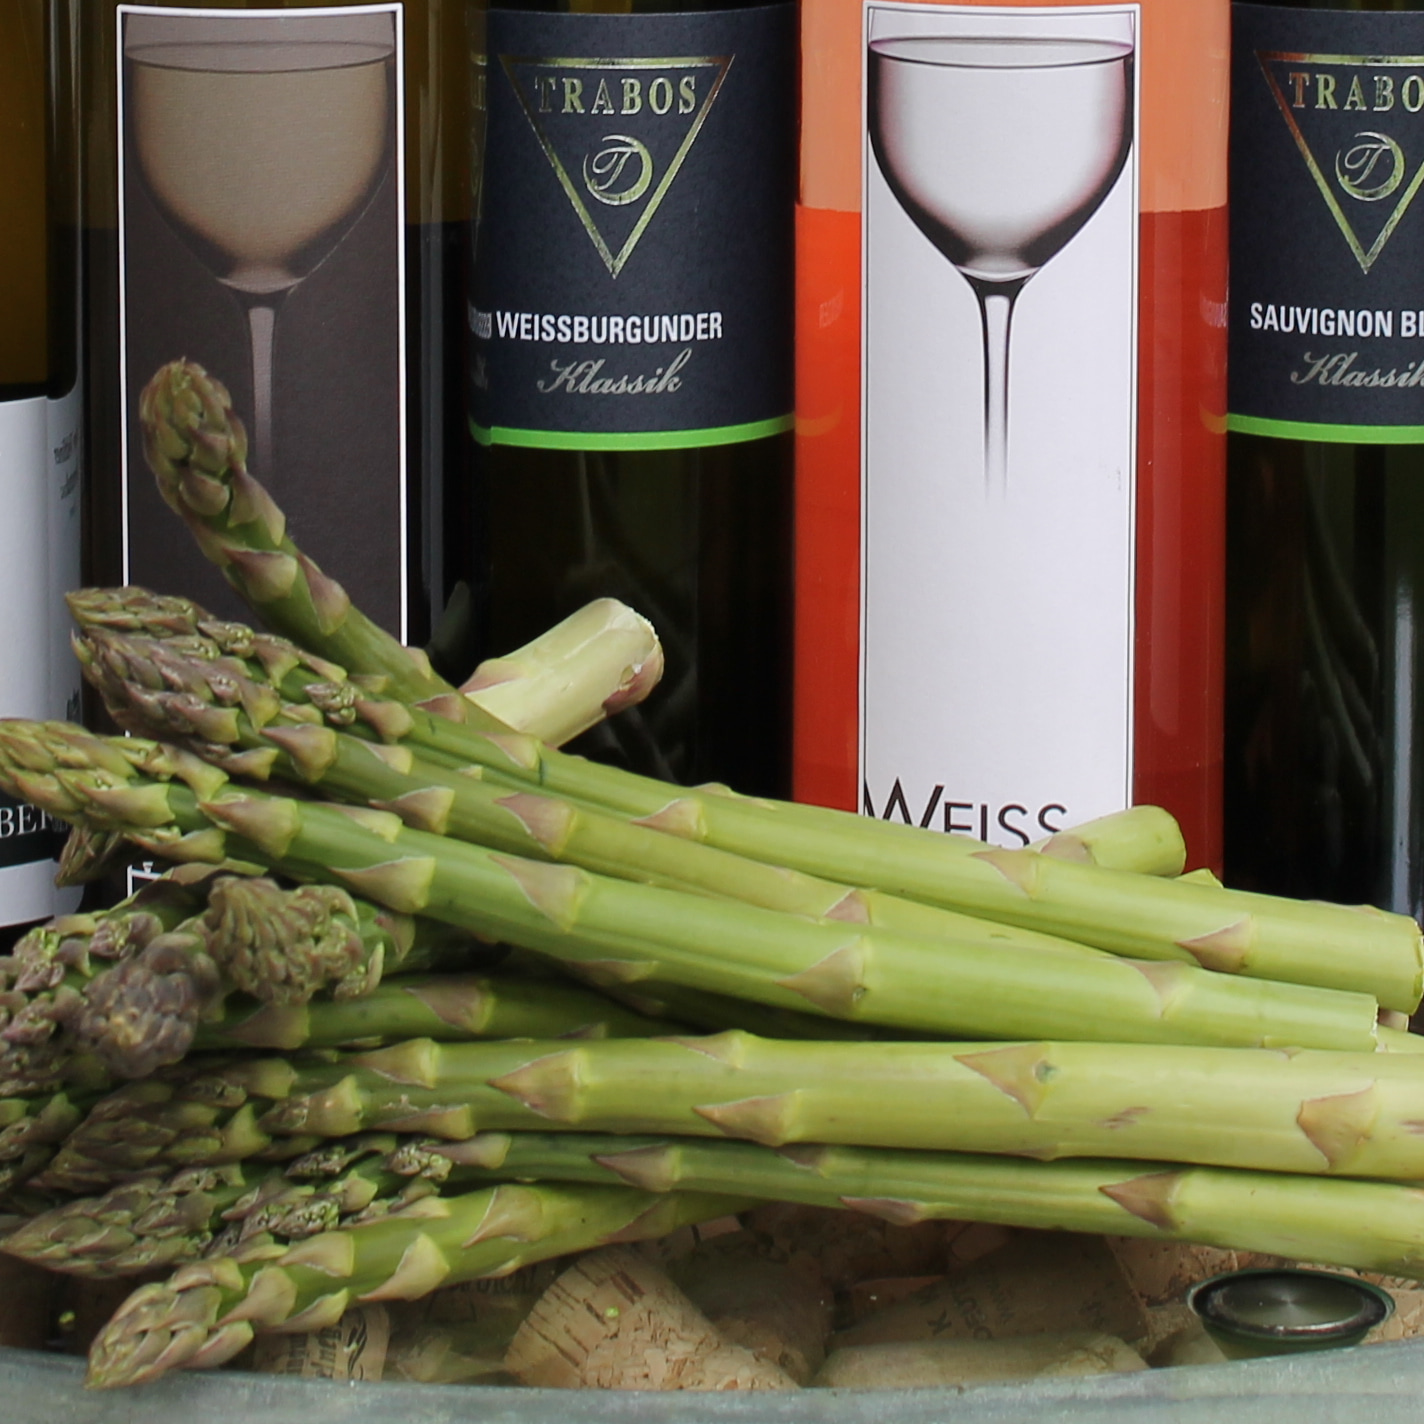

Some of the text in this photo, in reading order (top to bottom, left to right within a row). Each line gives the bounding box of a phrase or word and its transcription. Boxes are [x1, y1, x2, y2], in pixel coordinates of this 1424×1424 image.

[534, 75, 697, 116] TRABOS
[496, 311, 723, 344] WEISSBURGUNDER
[1250, 302, 1393, 338] SAUVIGNON
[537, 348, 692, 394] Klassik
